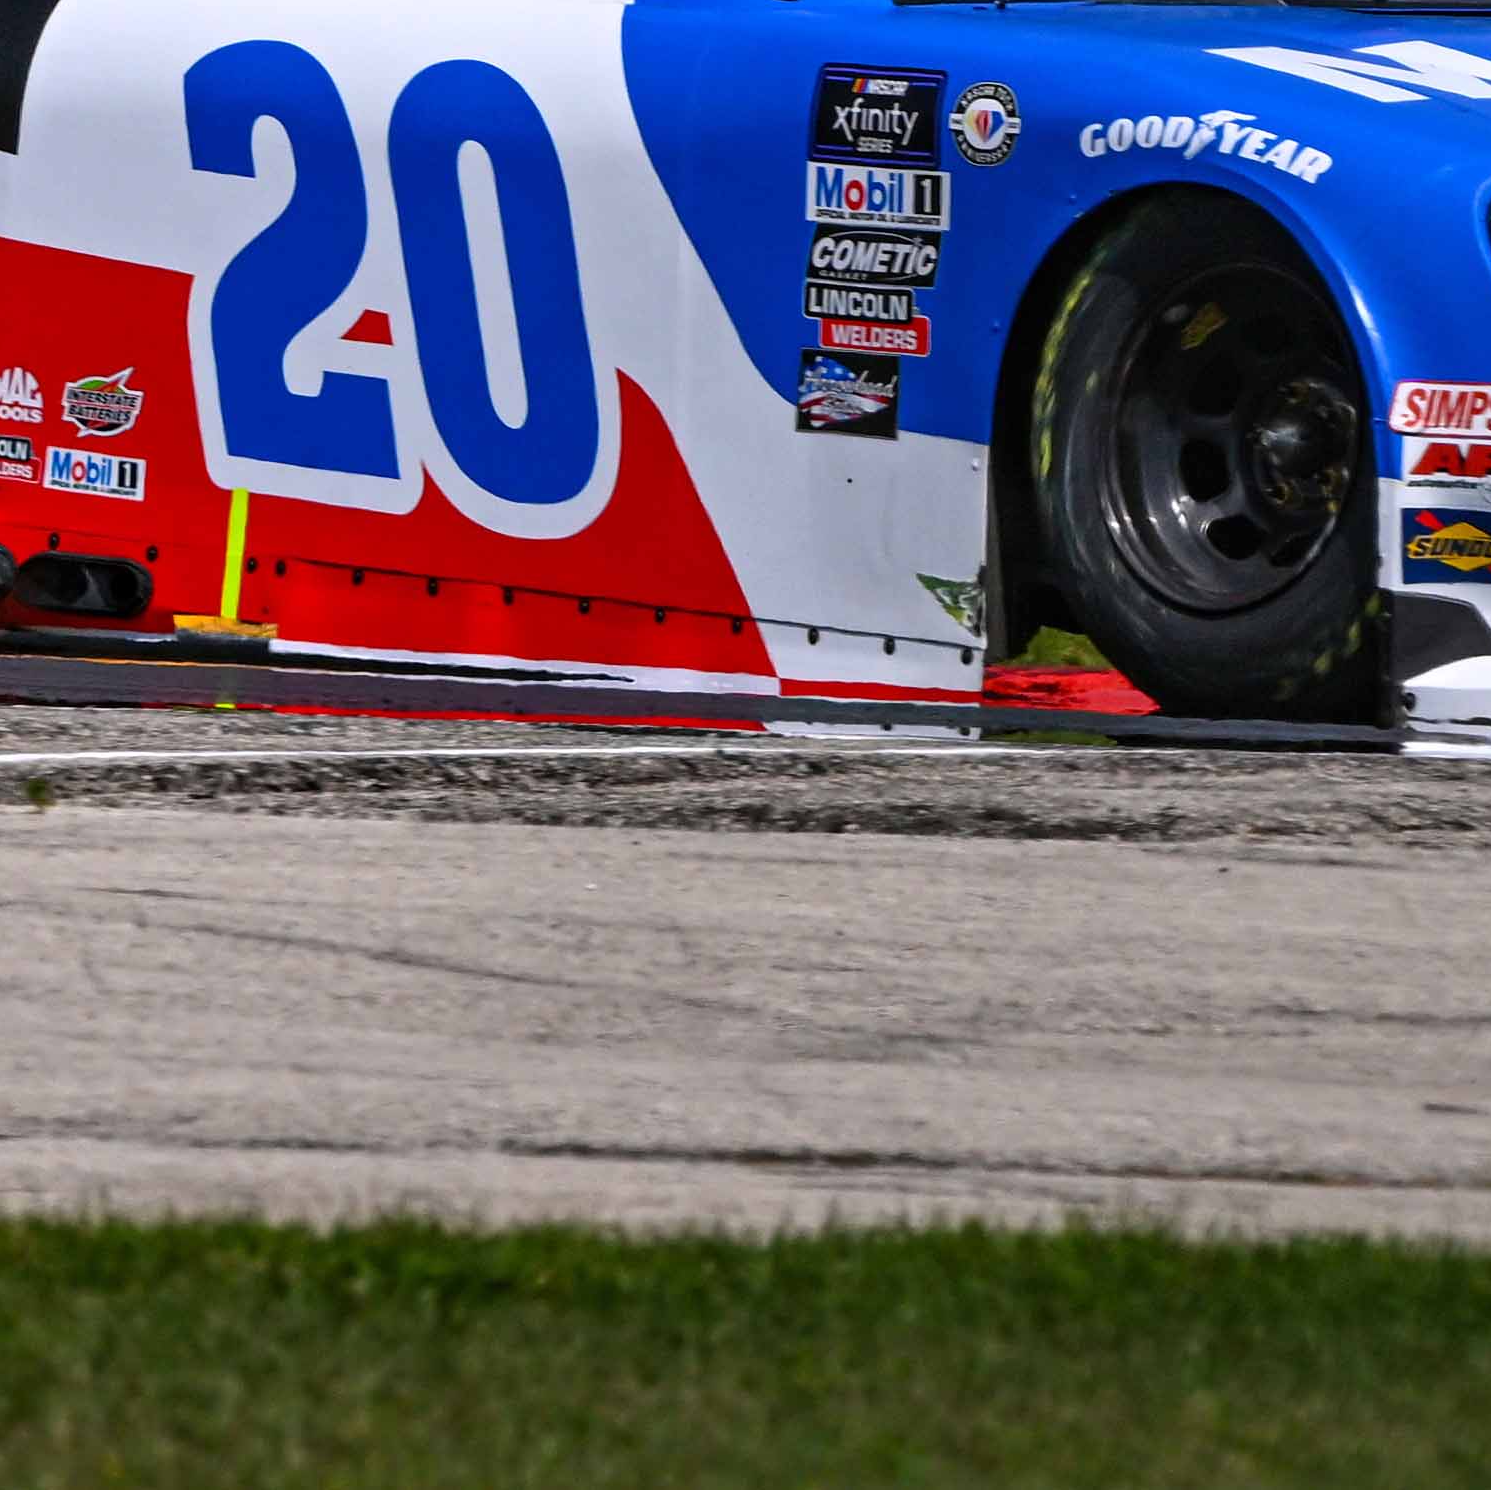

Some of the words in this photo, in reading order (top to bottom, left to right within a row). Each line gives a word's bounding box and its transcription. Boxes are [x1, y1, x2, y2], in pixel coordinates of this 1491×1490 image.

[832, 97, 919, 146] xfinity
[1079, 110, 1335, 185] GOODYEAR
[815, 166, 904, 213] Mobil
[183, 39, 600, 506] 20
[812, 237, 939, 276] COMETIC
[809, 287, 909, 320] LINCOLN
[830, 323, 917, 350] WELDERS
[66, 389, 138, 408] INTERSTATE
[67, 405, 132, 422] BATTERIES
[51, 451, 113, 486] Mobil
